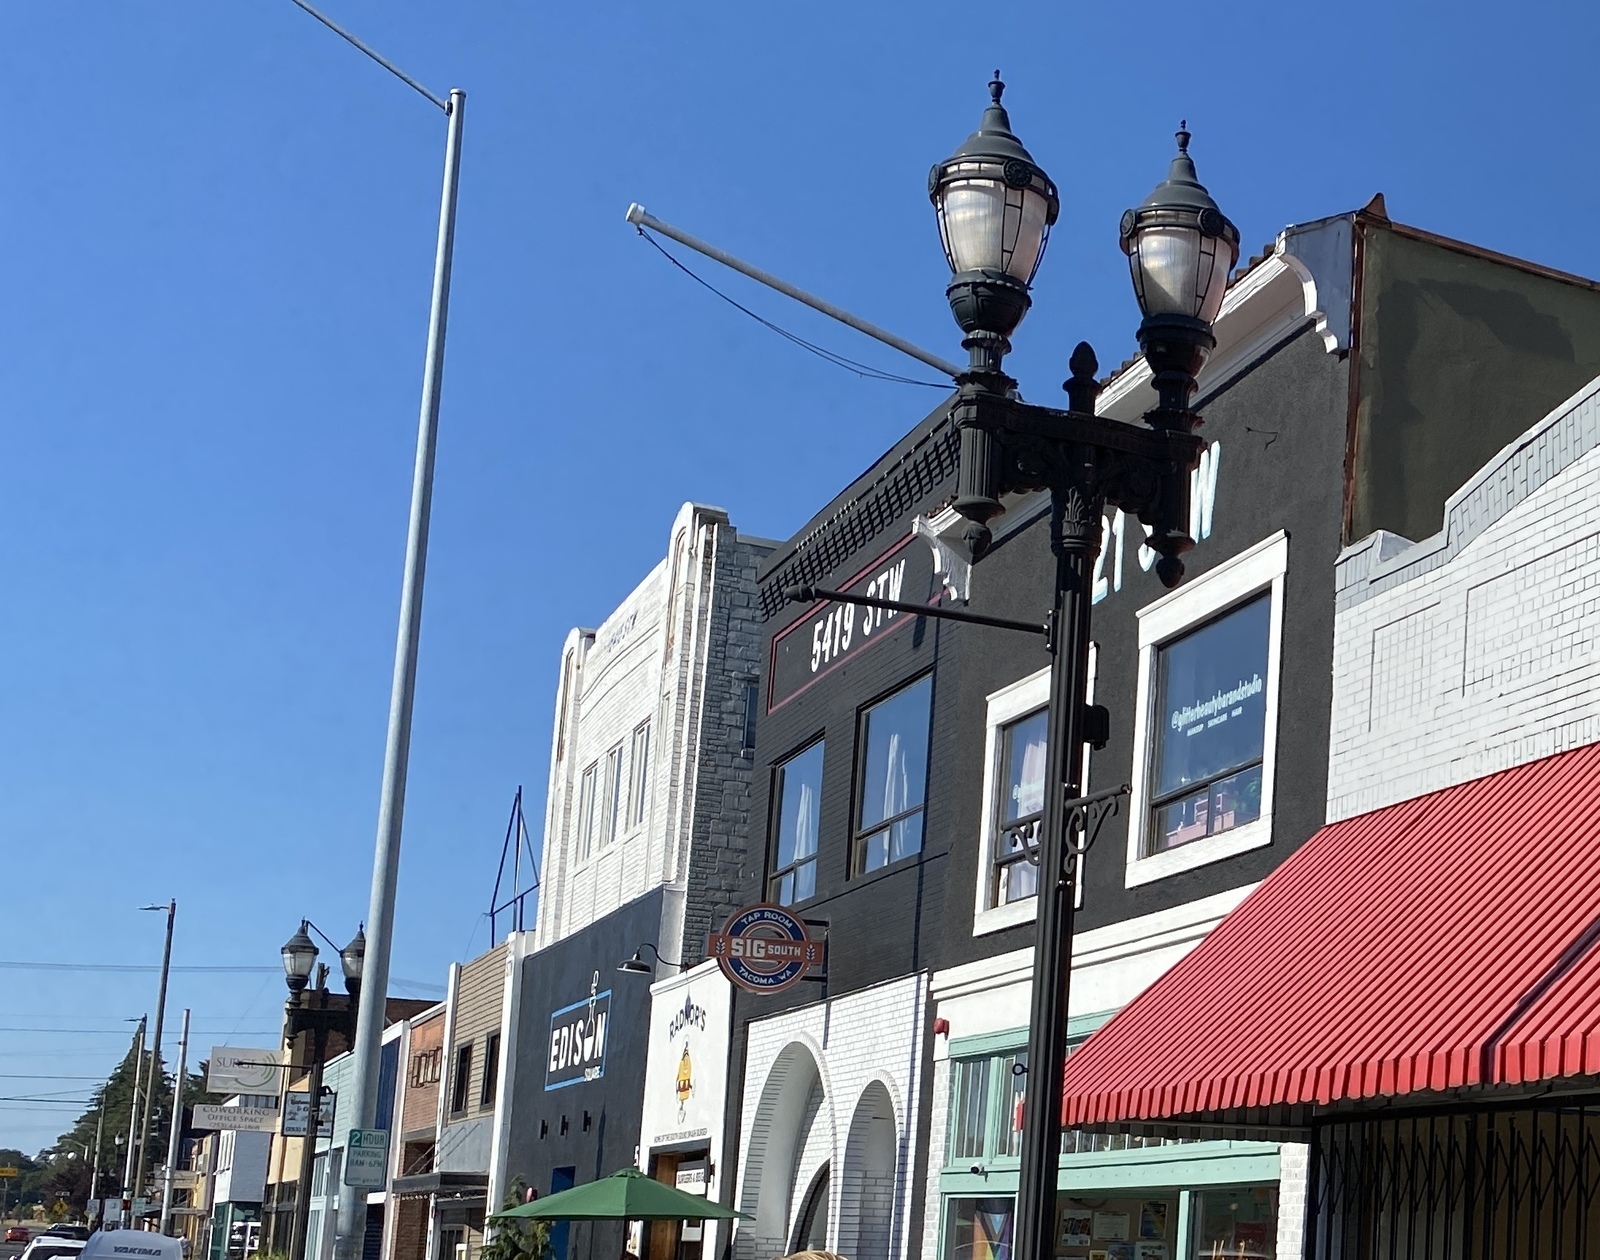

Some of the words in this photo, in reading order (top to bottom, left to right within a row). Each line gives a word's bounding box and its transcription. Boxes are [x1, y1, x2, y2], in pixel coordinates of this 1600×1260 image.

[811, 602, 855, 673] 5419
[741, 911, 761, 925] TAP
[764, 911, 793, 929] ROOM
[731, 938, 766, 958] SIG
[767, 944, 801, 957] SOUTH
[778, 969, 793, 981] WA
[549, 1011, 606, 1073] EDISON
[203, 1105, 270, 1116] COWORKING
[207, 1113, 237, 1122] OFFICE
[351, 1131, 360, 1146] 2
[363, 1133, 384, 1146] HOUR
[353, 1150, 381, 1158] PARKING
[113, 1246, 162, 1256] YAKIMA
